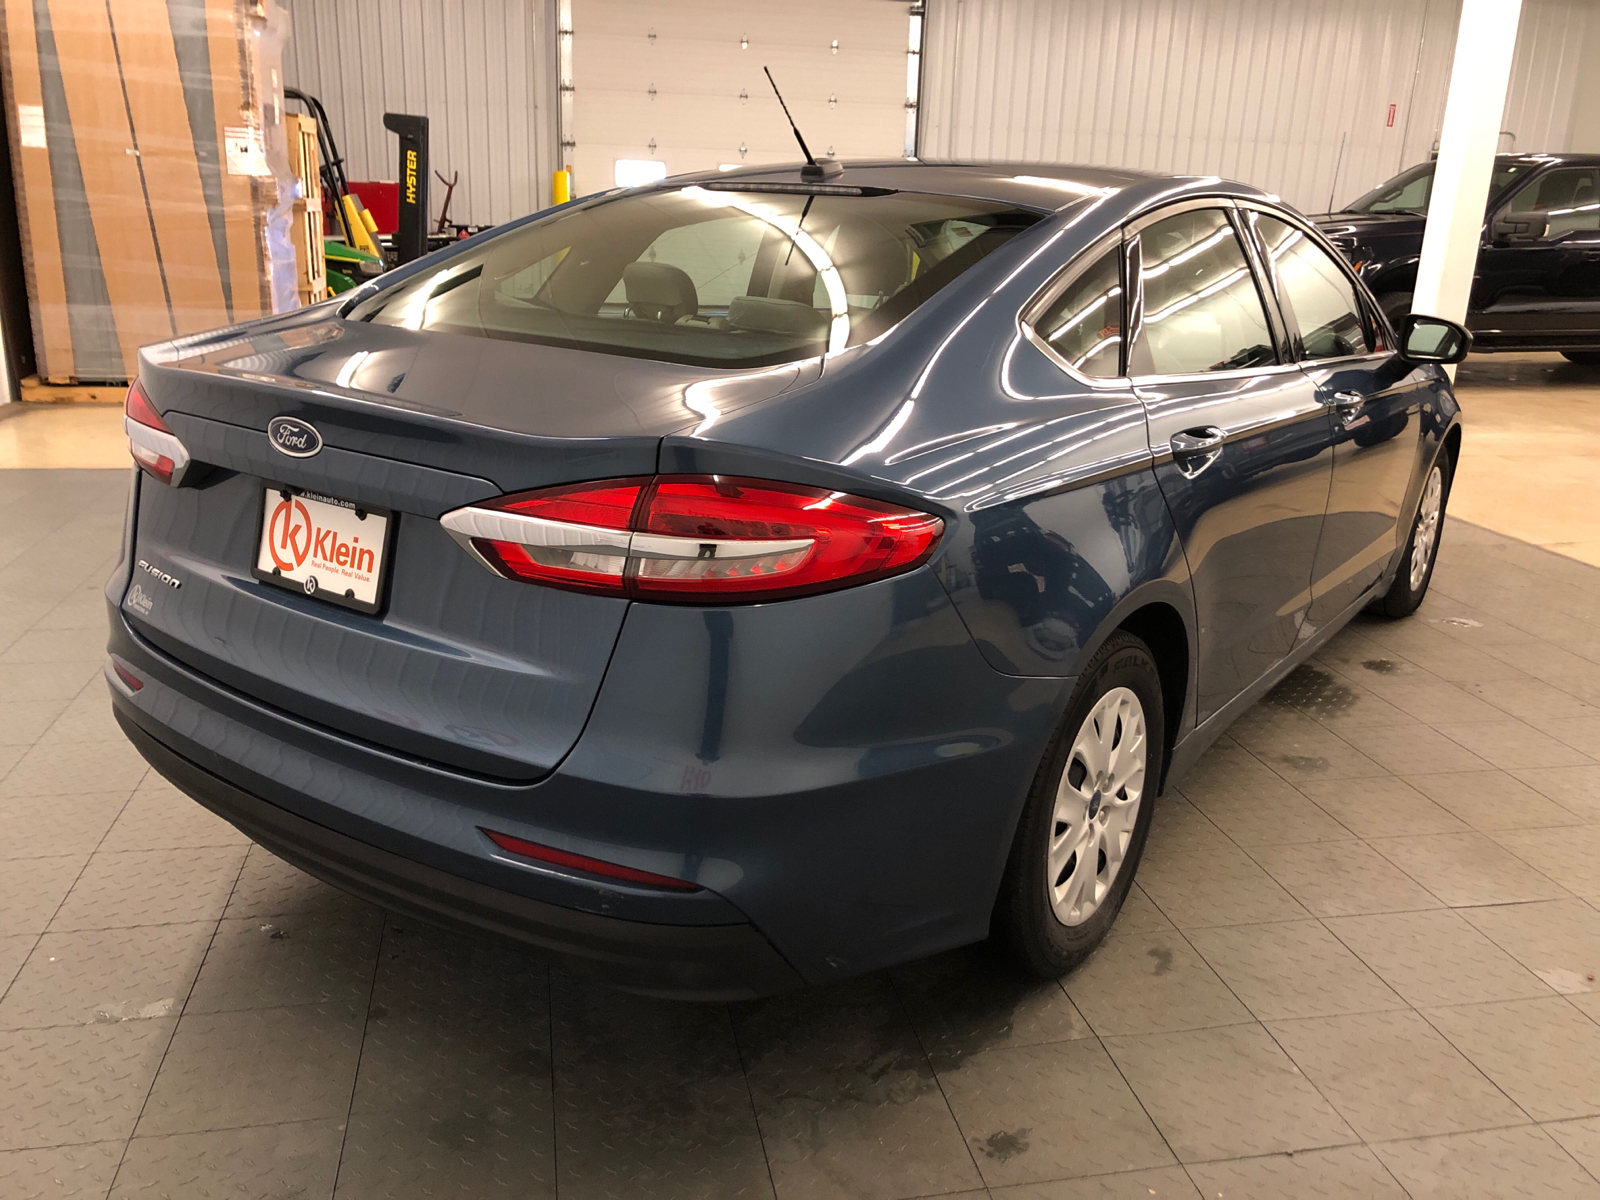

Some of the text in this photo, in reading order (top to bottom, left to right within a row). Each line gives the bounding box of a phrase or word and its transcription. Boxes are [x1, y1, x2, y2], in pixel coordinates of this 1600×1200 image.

[406, 150, 417, 204] HYSTER
[277, 424, 307, 449] Ford
[313, 527, 374, 573] Klein
[138, 560, 181, 589] FUSION
[311, 560, 372, 583] Real People. Real Value.
